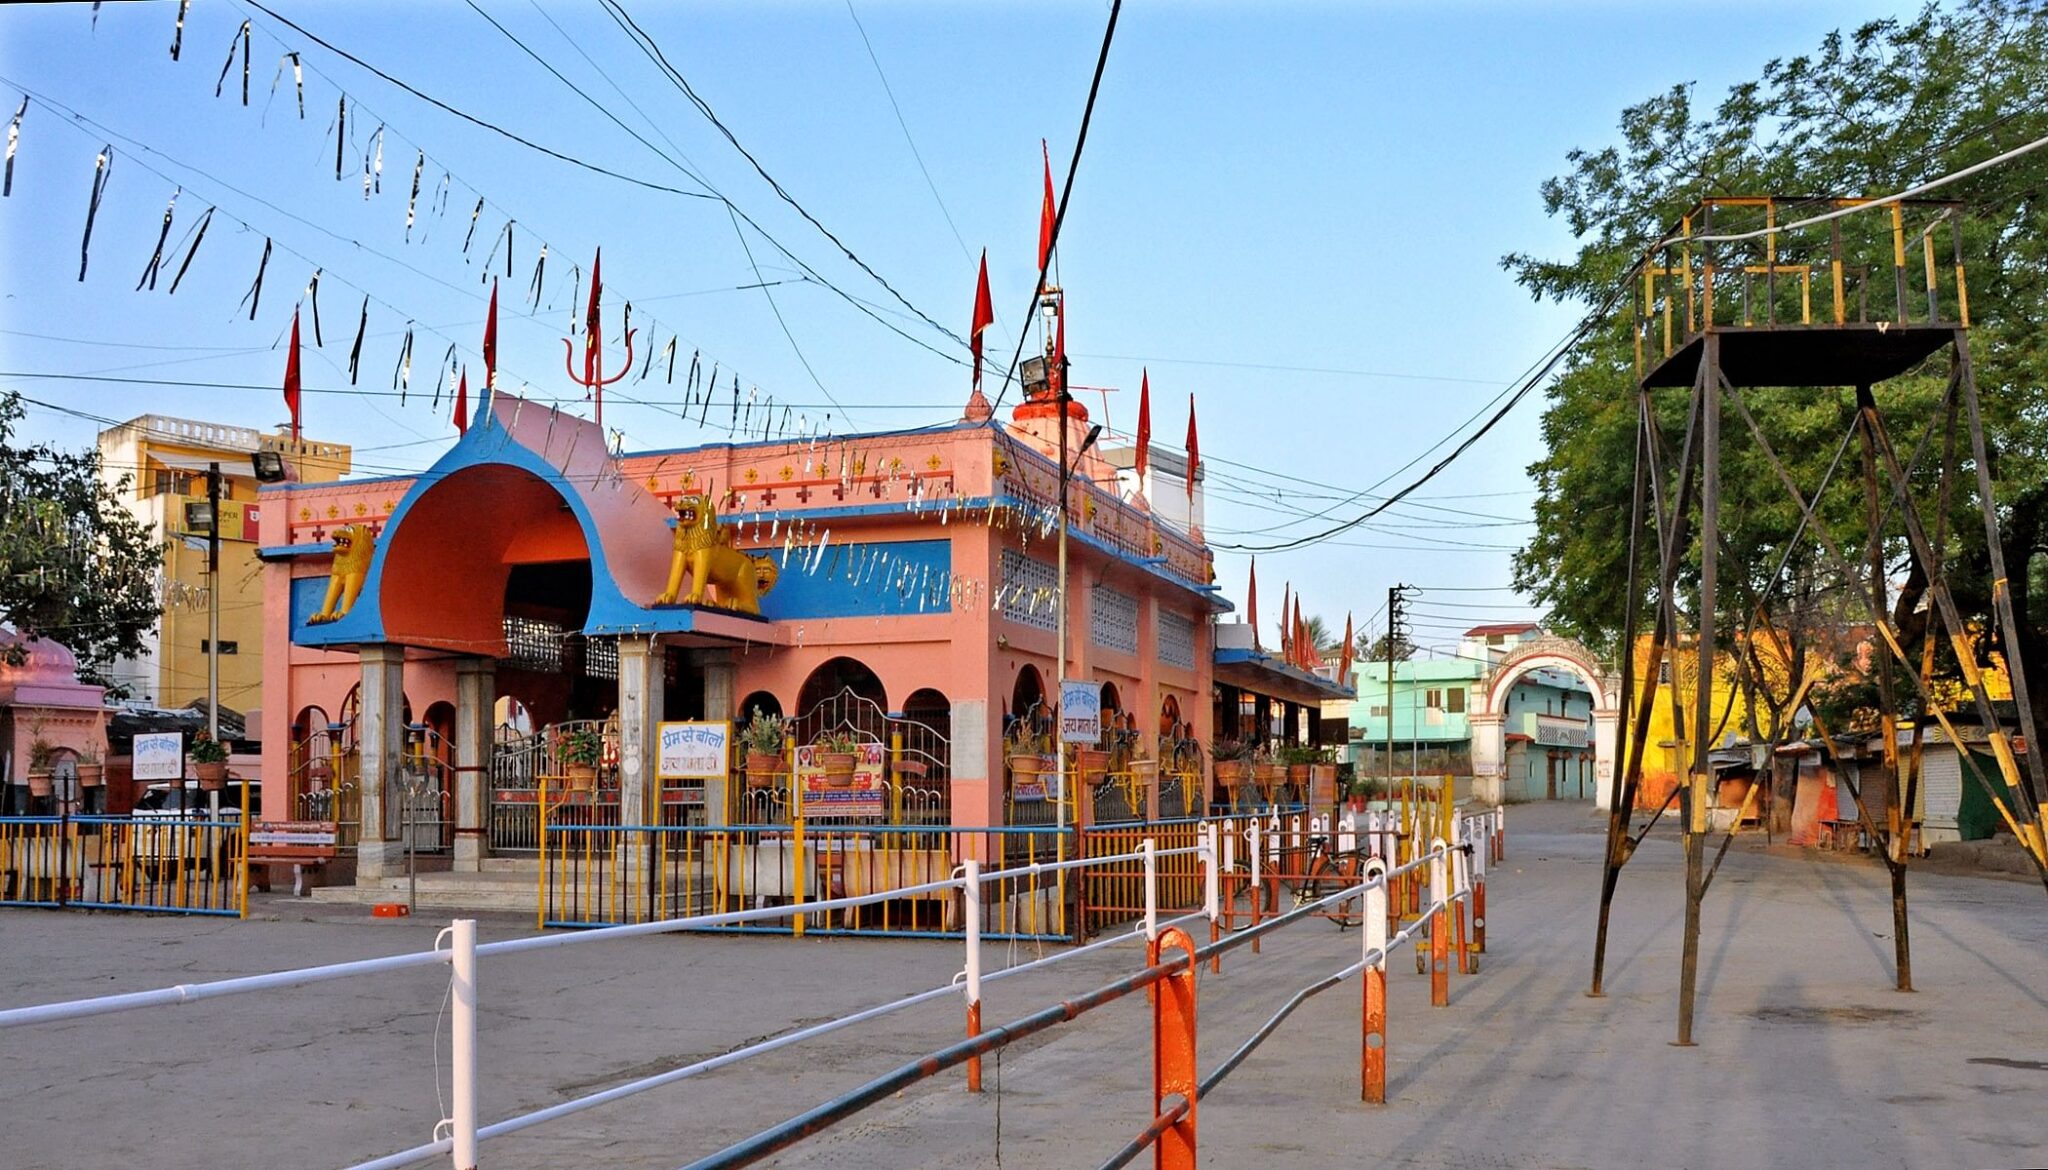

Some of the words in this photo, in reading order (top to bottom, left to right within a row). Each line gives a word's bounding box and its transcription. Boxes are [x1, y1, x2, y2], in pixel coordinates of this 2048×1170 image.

[1063, 718, 1076, 734] जय
[1077, 718, 1091, 734] माता
[1091, 714, 1098, 737] दी
[662, 731, 679, 750] प्रेम
[682, 727, 694, 742] से
[695, 727, 724, 748] बोलो
